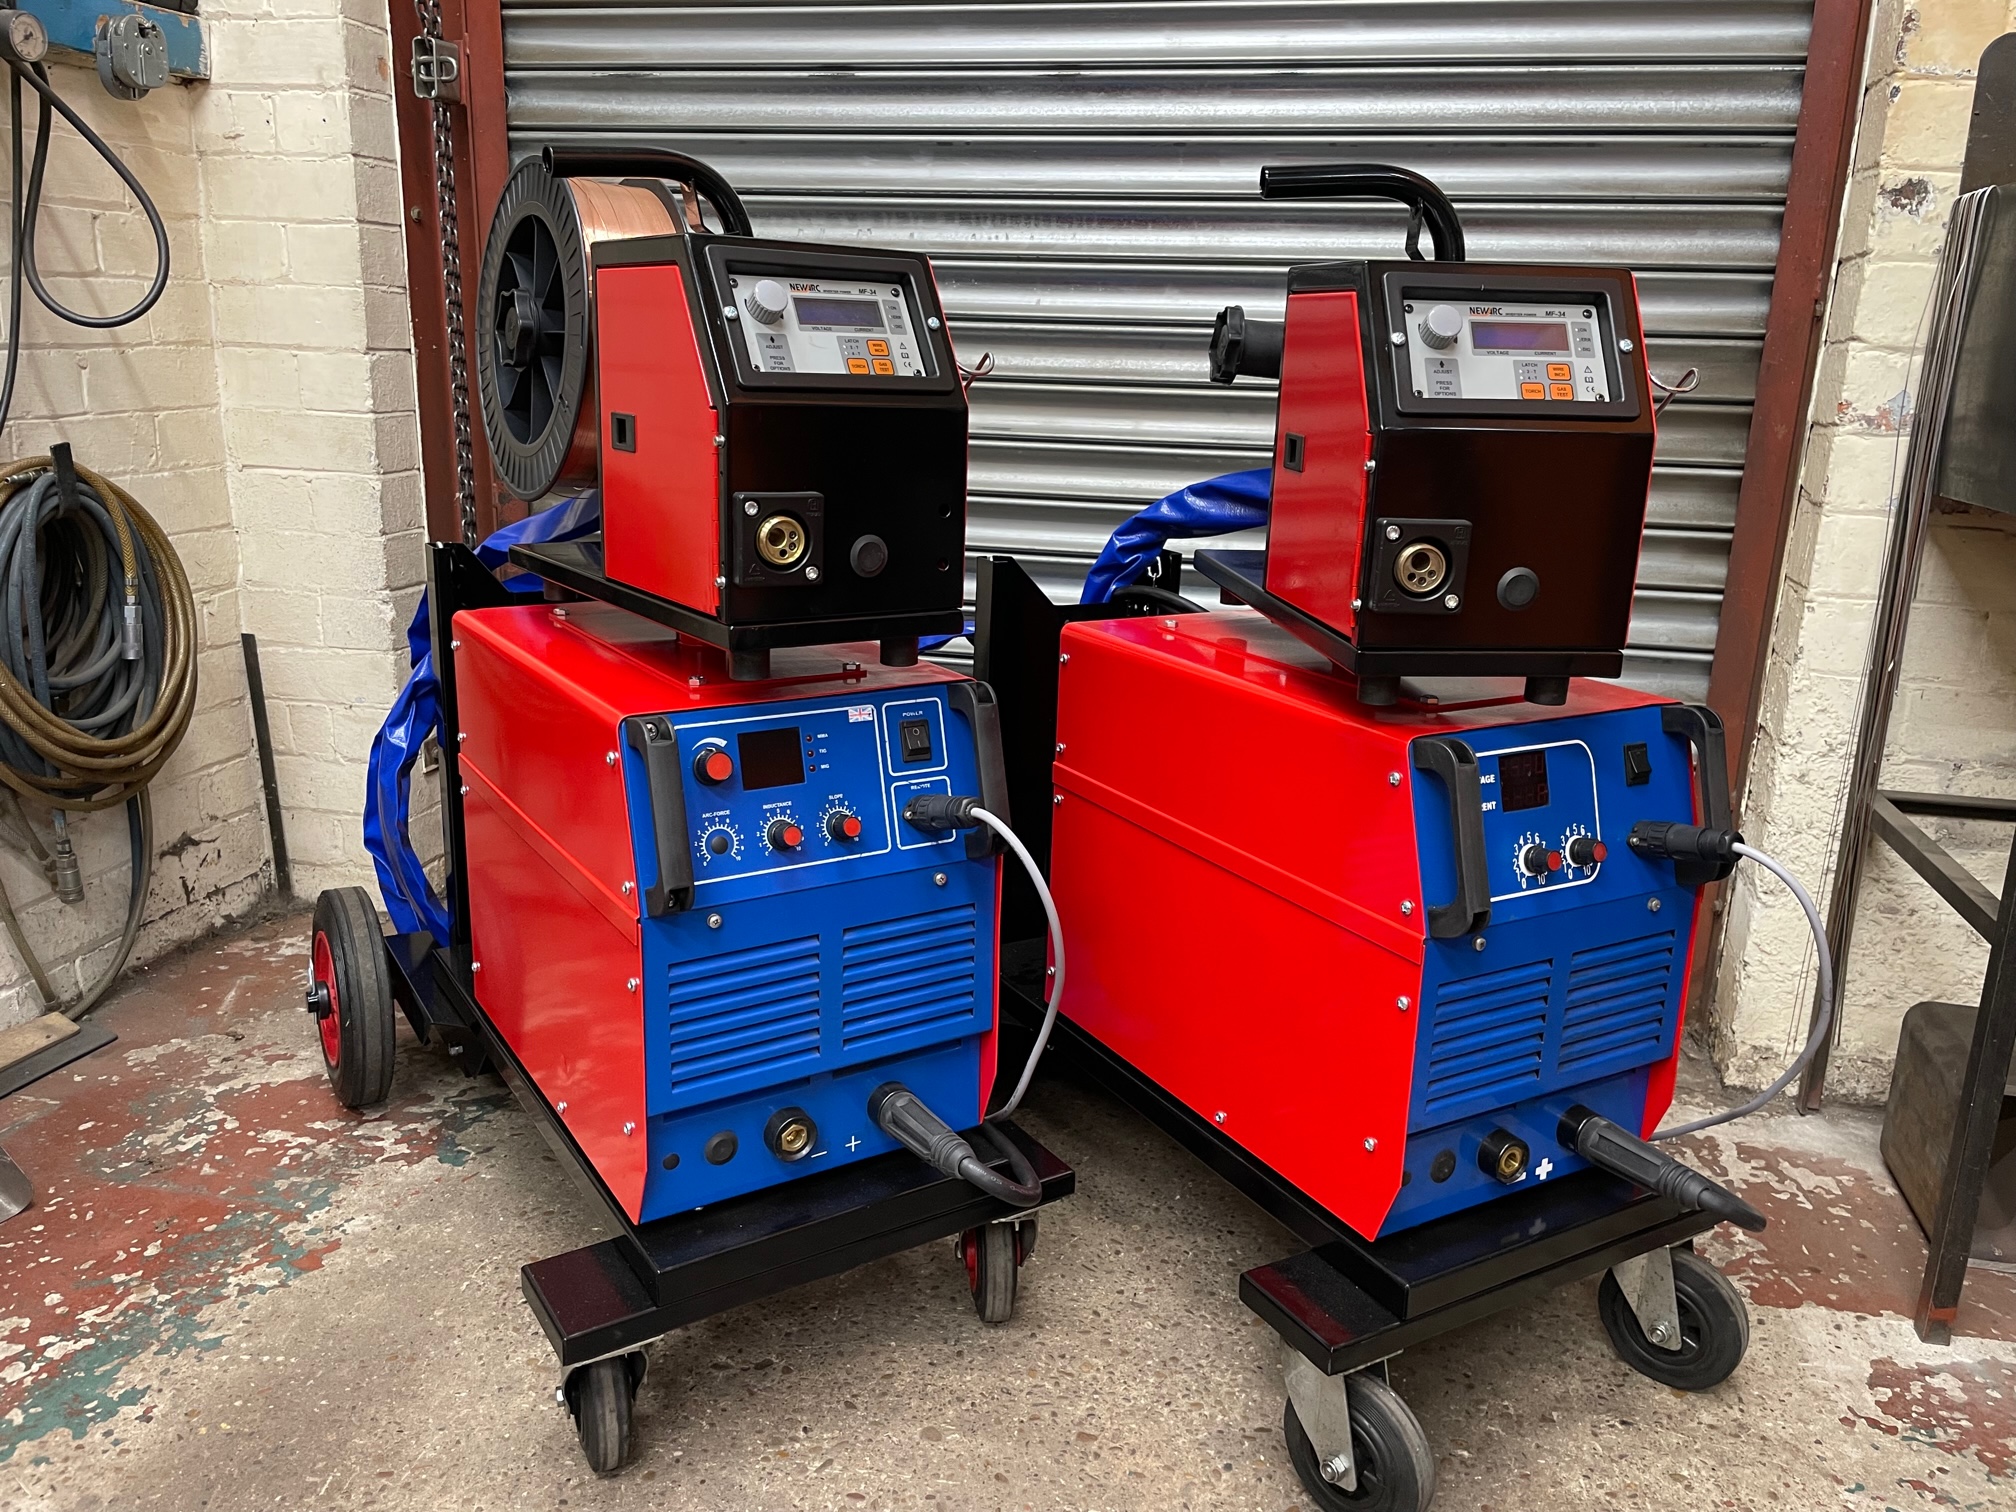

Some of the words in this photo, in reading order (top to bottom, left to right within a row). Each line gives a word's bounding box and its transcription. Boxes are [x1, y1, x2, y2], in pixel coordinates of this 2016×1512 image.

[1468, 306, 1503, 316] NEWARC
[762, 801, 792, 809] INDUCTANCE
[702, 809, 731, 818] ARC-FORCE
[1565, 826, 1570, 837] 4
[1572, 823, 1578, 835] 5
[1580, 824, 1586, 836] 6
[1519, 835, 1524, 846] 4
[1526, 831, 1532, 843] 5
[1534, 832, 1540, 844] 6
[1560, 835, 1566, 847] 3
[1513, 843, 1519, 856] 3
[1512, 858, 1519, 870] 2
[1583, 864, 1592, 876] 10
[1537, 874, 1546, 885] 10
[1568, 868, 1573, 880] 0
[1521, 877, 1527, 889] 0
